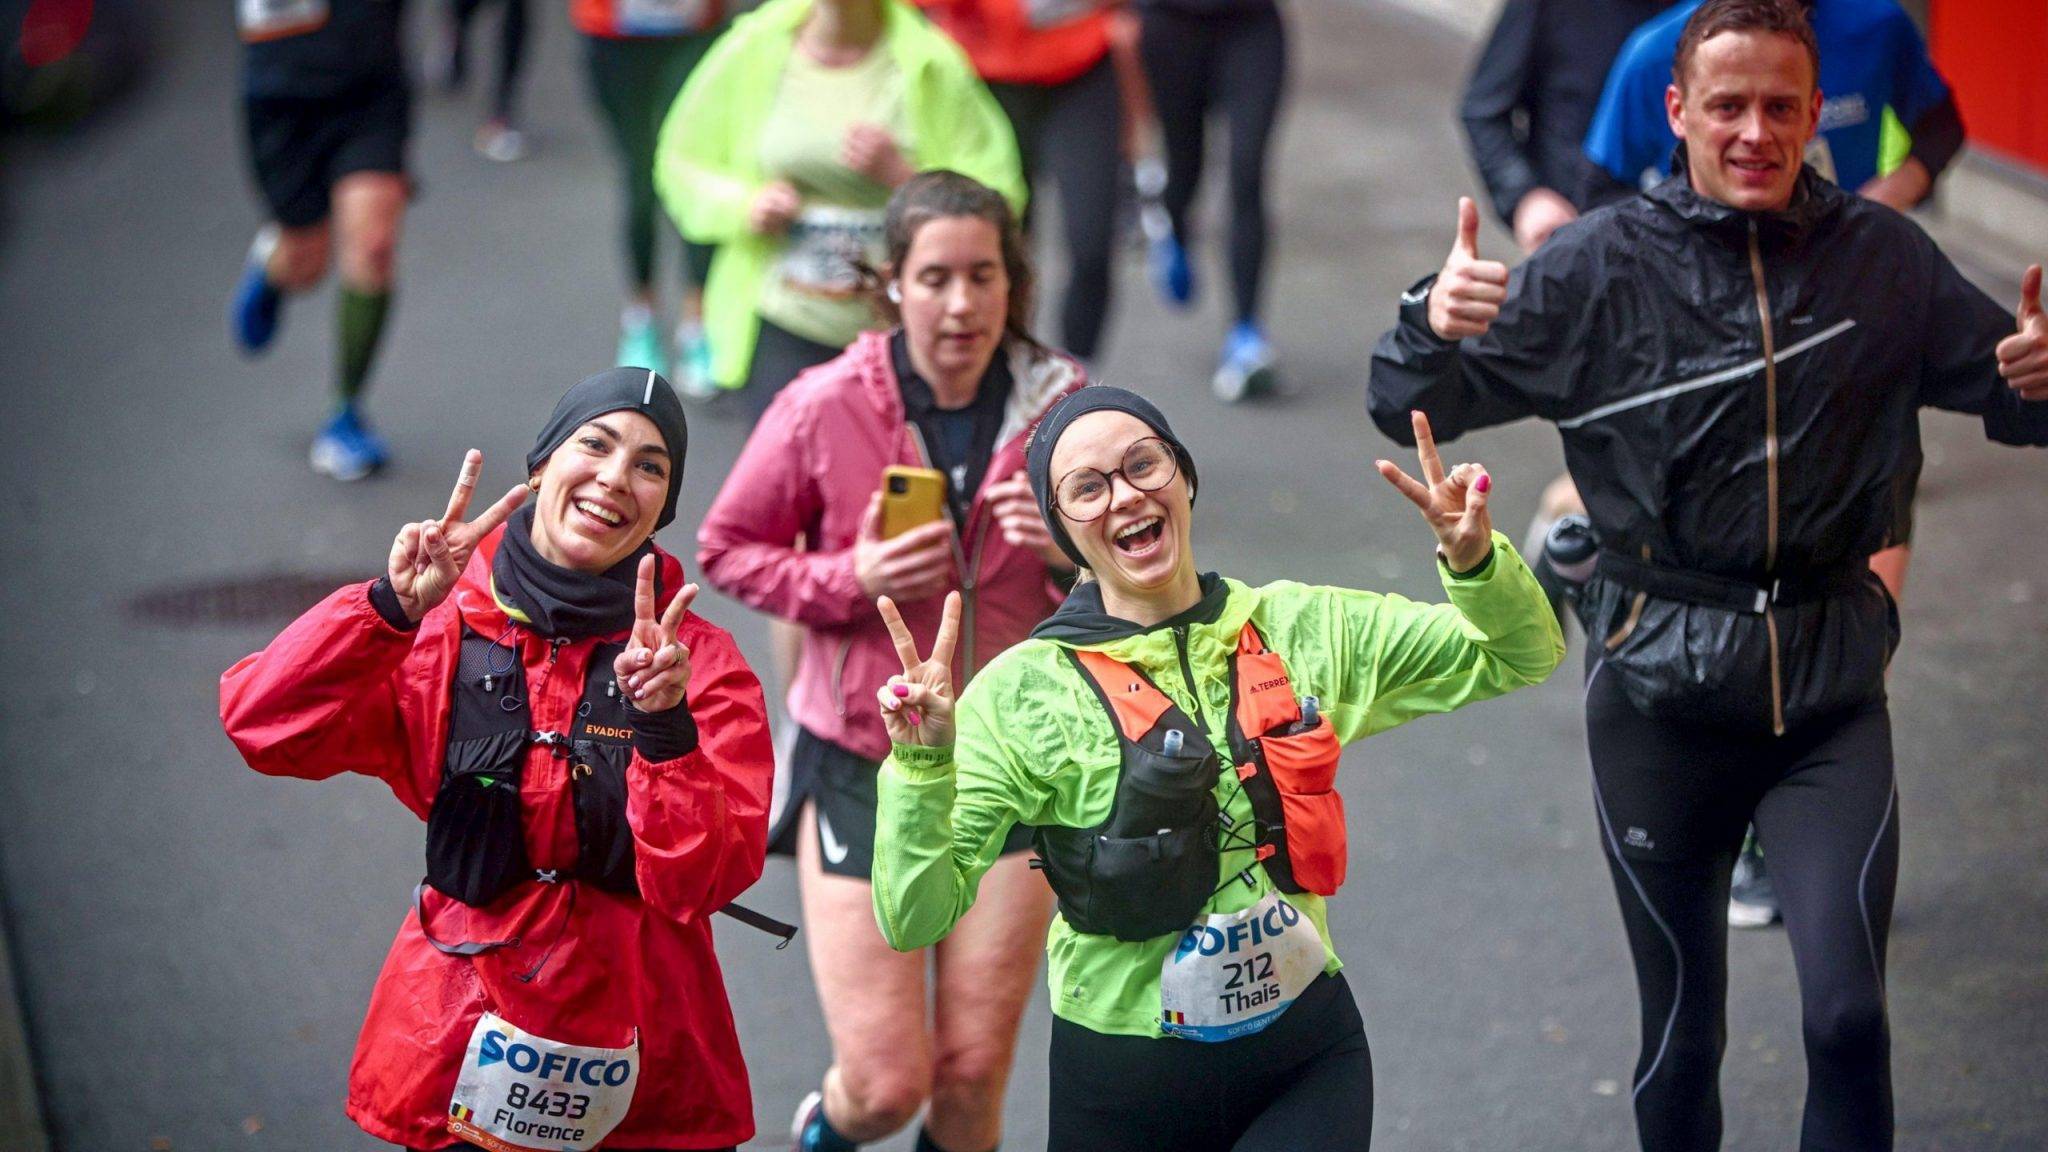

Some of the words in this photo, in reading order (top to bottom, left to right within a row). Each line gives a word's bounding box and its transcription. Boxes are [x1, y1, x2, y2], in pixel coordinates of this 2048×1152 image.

[585, 724, 633, 739] EVADICT
[1177, 899, 1299, 957] SOFICO
[1222, 952, 1274, 990] 212
[1219, 983, 1281, 1014] Thais
[480, 1030, 631, 1086] SOFICO
[506, 1082, 591, 1120] 8433
[493, 1108, 585, 1141] Florence
